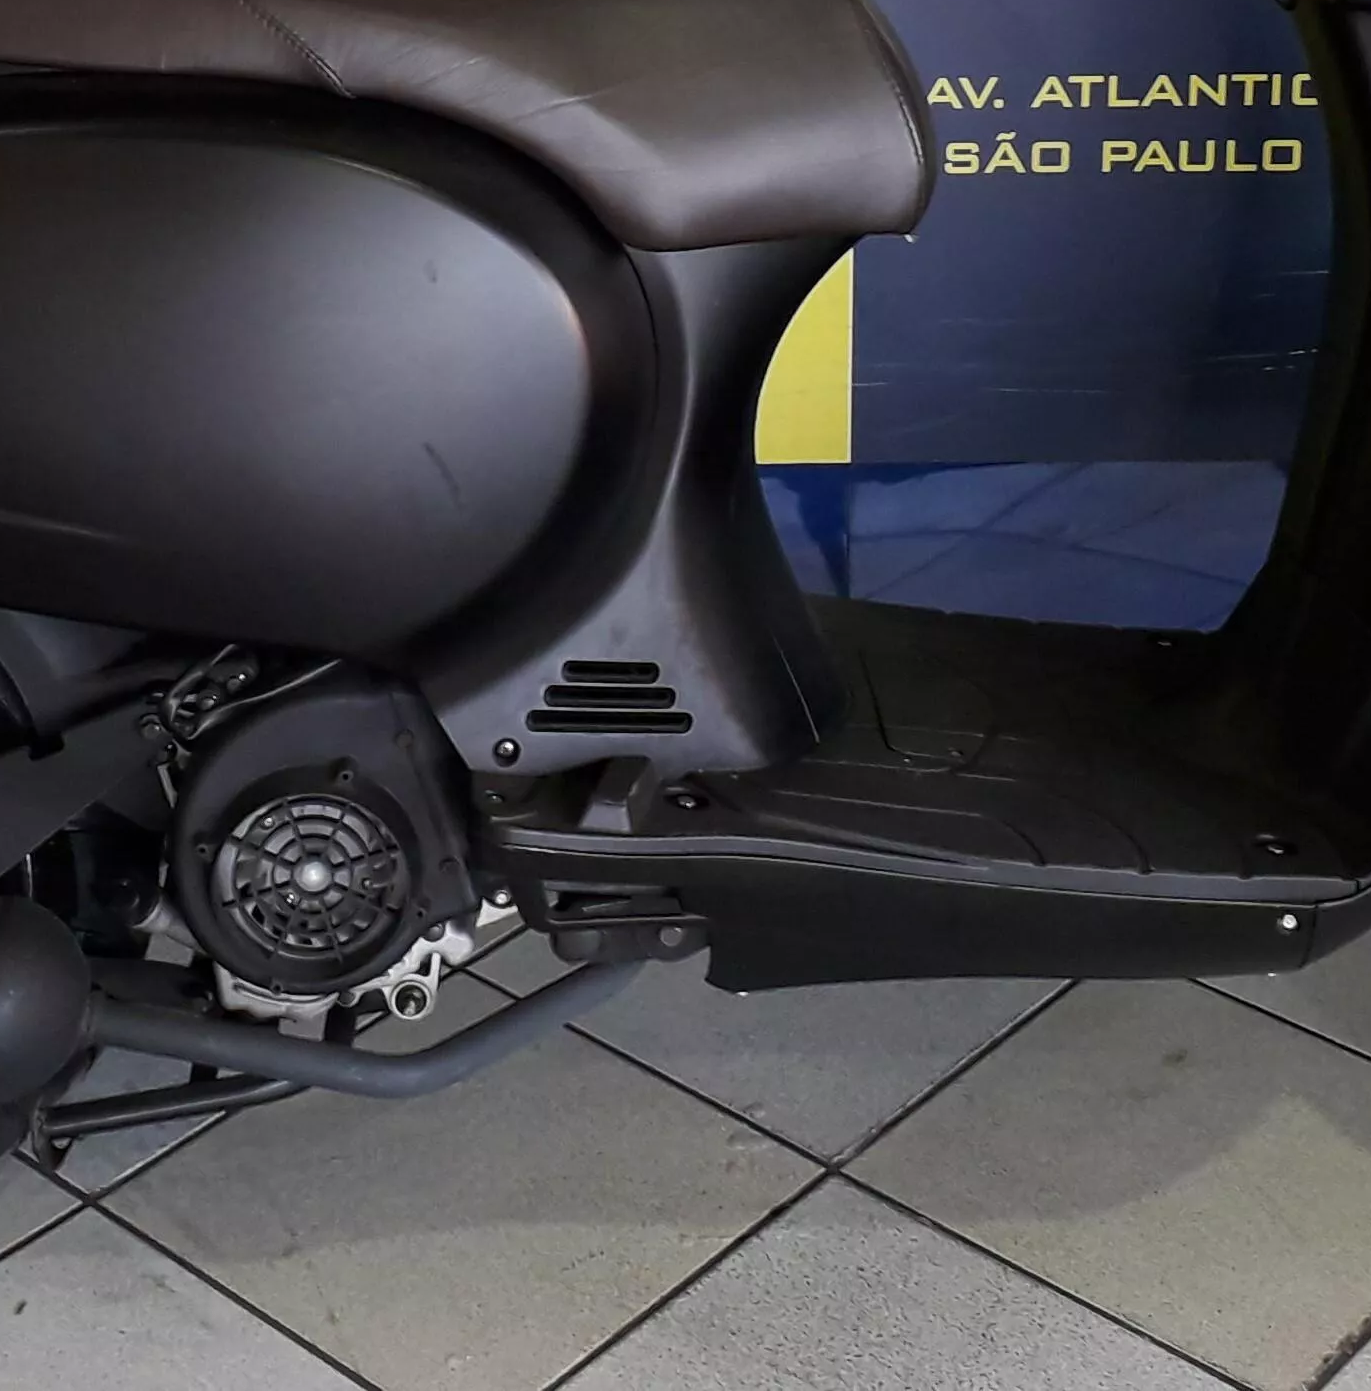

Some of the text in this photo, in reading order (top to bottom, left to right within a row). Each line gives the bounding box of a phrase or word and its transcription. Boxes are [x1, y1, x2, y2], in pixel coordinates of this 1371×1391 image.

[927, 76, 1006, 110] AV.
[943, 131, 1303, 176] SÃO PAULO
